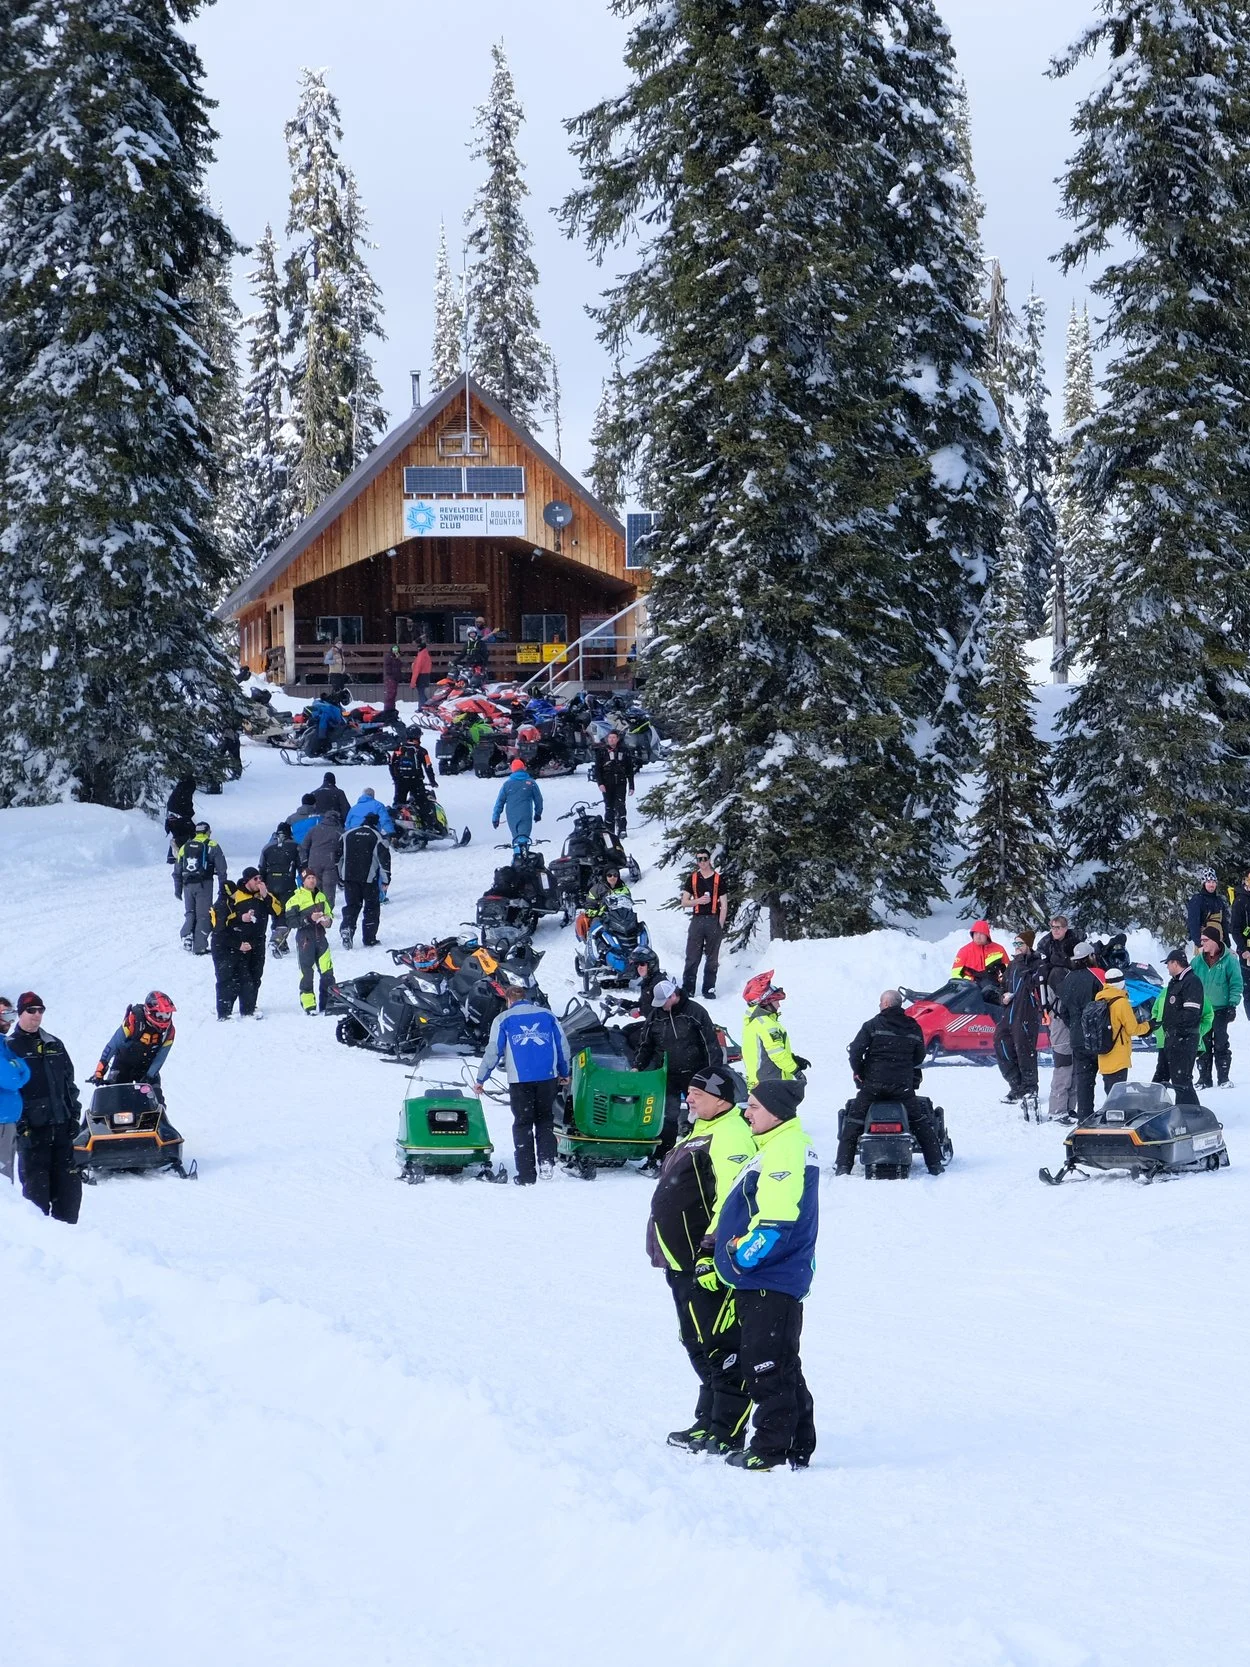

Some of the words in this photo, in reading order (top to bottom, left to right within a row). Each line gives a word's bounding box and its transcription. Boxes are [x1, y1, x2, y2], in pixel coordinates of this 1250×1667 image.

[642, 1096, 655, 1124] 600
[743, 1232, 767, 1261] FXR
[695, 1264, 711, 1274] FXR
